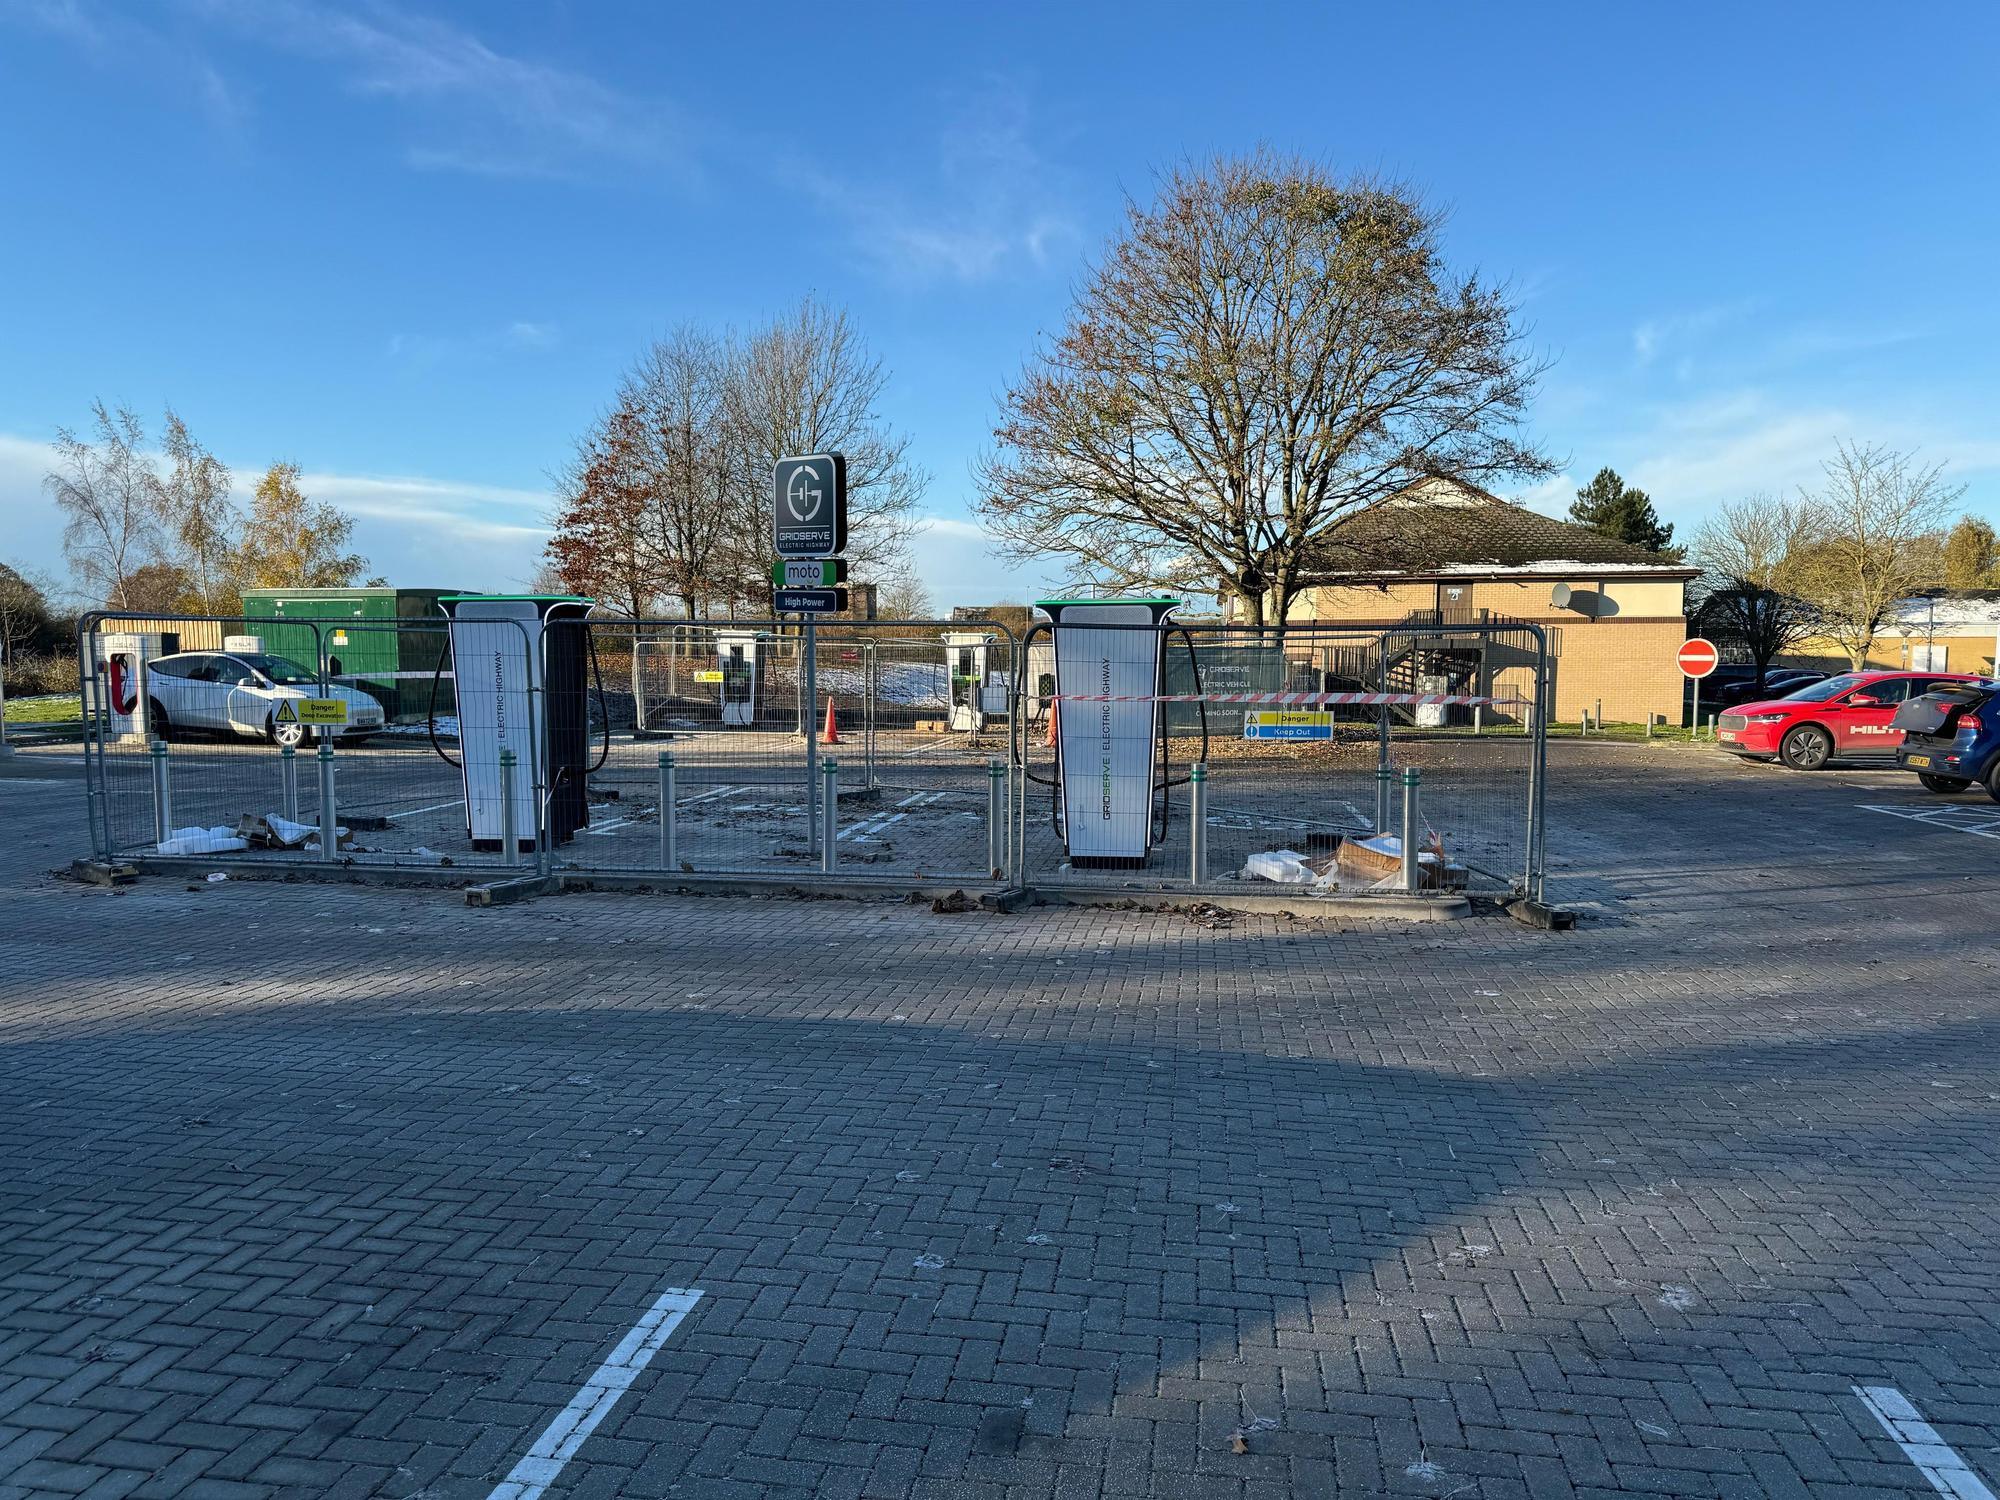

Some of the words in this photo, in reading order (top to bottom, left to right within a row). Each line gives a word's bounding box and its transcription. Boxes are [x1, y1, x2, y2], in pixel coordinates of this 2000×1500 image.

[779, 531, 831, 541] GRIDSERVE
[788, 564, 820, 578] moto
[784, 597, 801, 607] High
[802, 598, 825, 607] Power
[495, 650, 504, 693] HIGHWAY
[311, 704, 336, 712] Danger
[1196, 709, 1221, 717] CMING
[497, 694, 505, 739] ELECTRIC
[1281, 715, 1310, 723] Danger
[1102, 705, 1111, 751] ELECTRIC
[1102, 758, 1111, 821] GRIDSERVE
